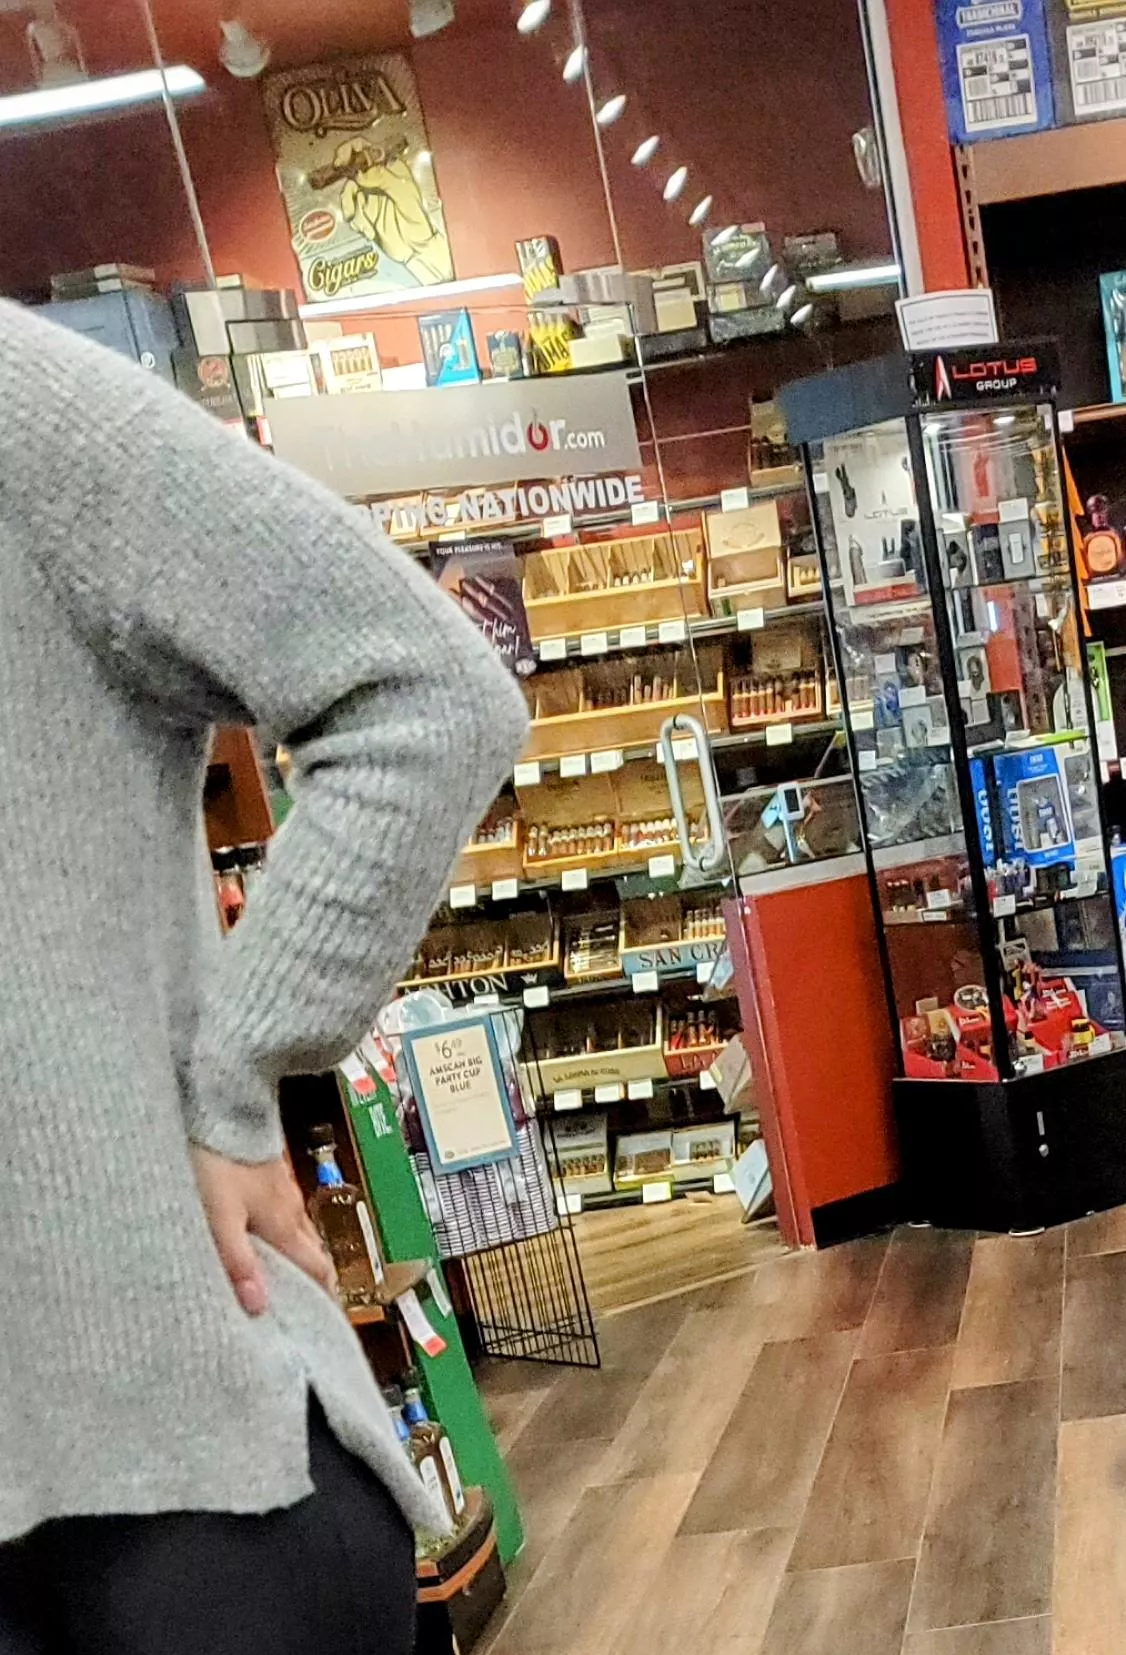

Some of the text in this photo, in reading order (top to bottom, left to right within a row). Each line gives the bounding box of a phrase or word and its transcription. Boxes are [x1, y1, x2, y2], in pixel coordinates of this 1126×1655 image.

[309, 250, 378, 296] Cigars
[951, 357, 1038, 379] LOTUS
[975, 377, 1018, 392] GROUP
[459, 474, 646, 525] NATIONWIDE
[639, 949, 682, 967] SAN
[467, 1055, 483, 1067] BIG
[435, 1067, 481, 1087] PARTY CUP
[450, 1080, 471, 1094] BLUE
